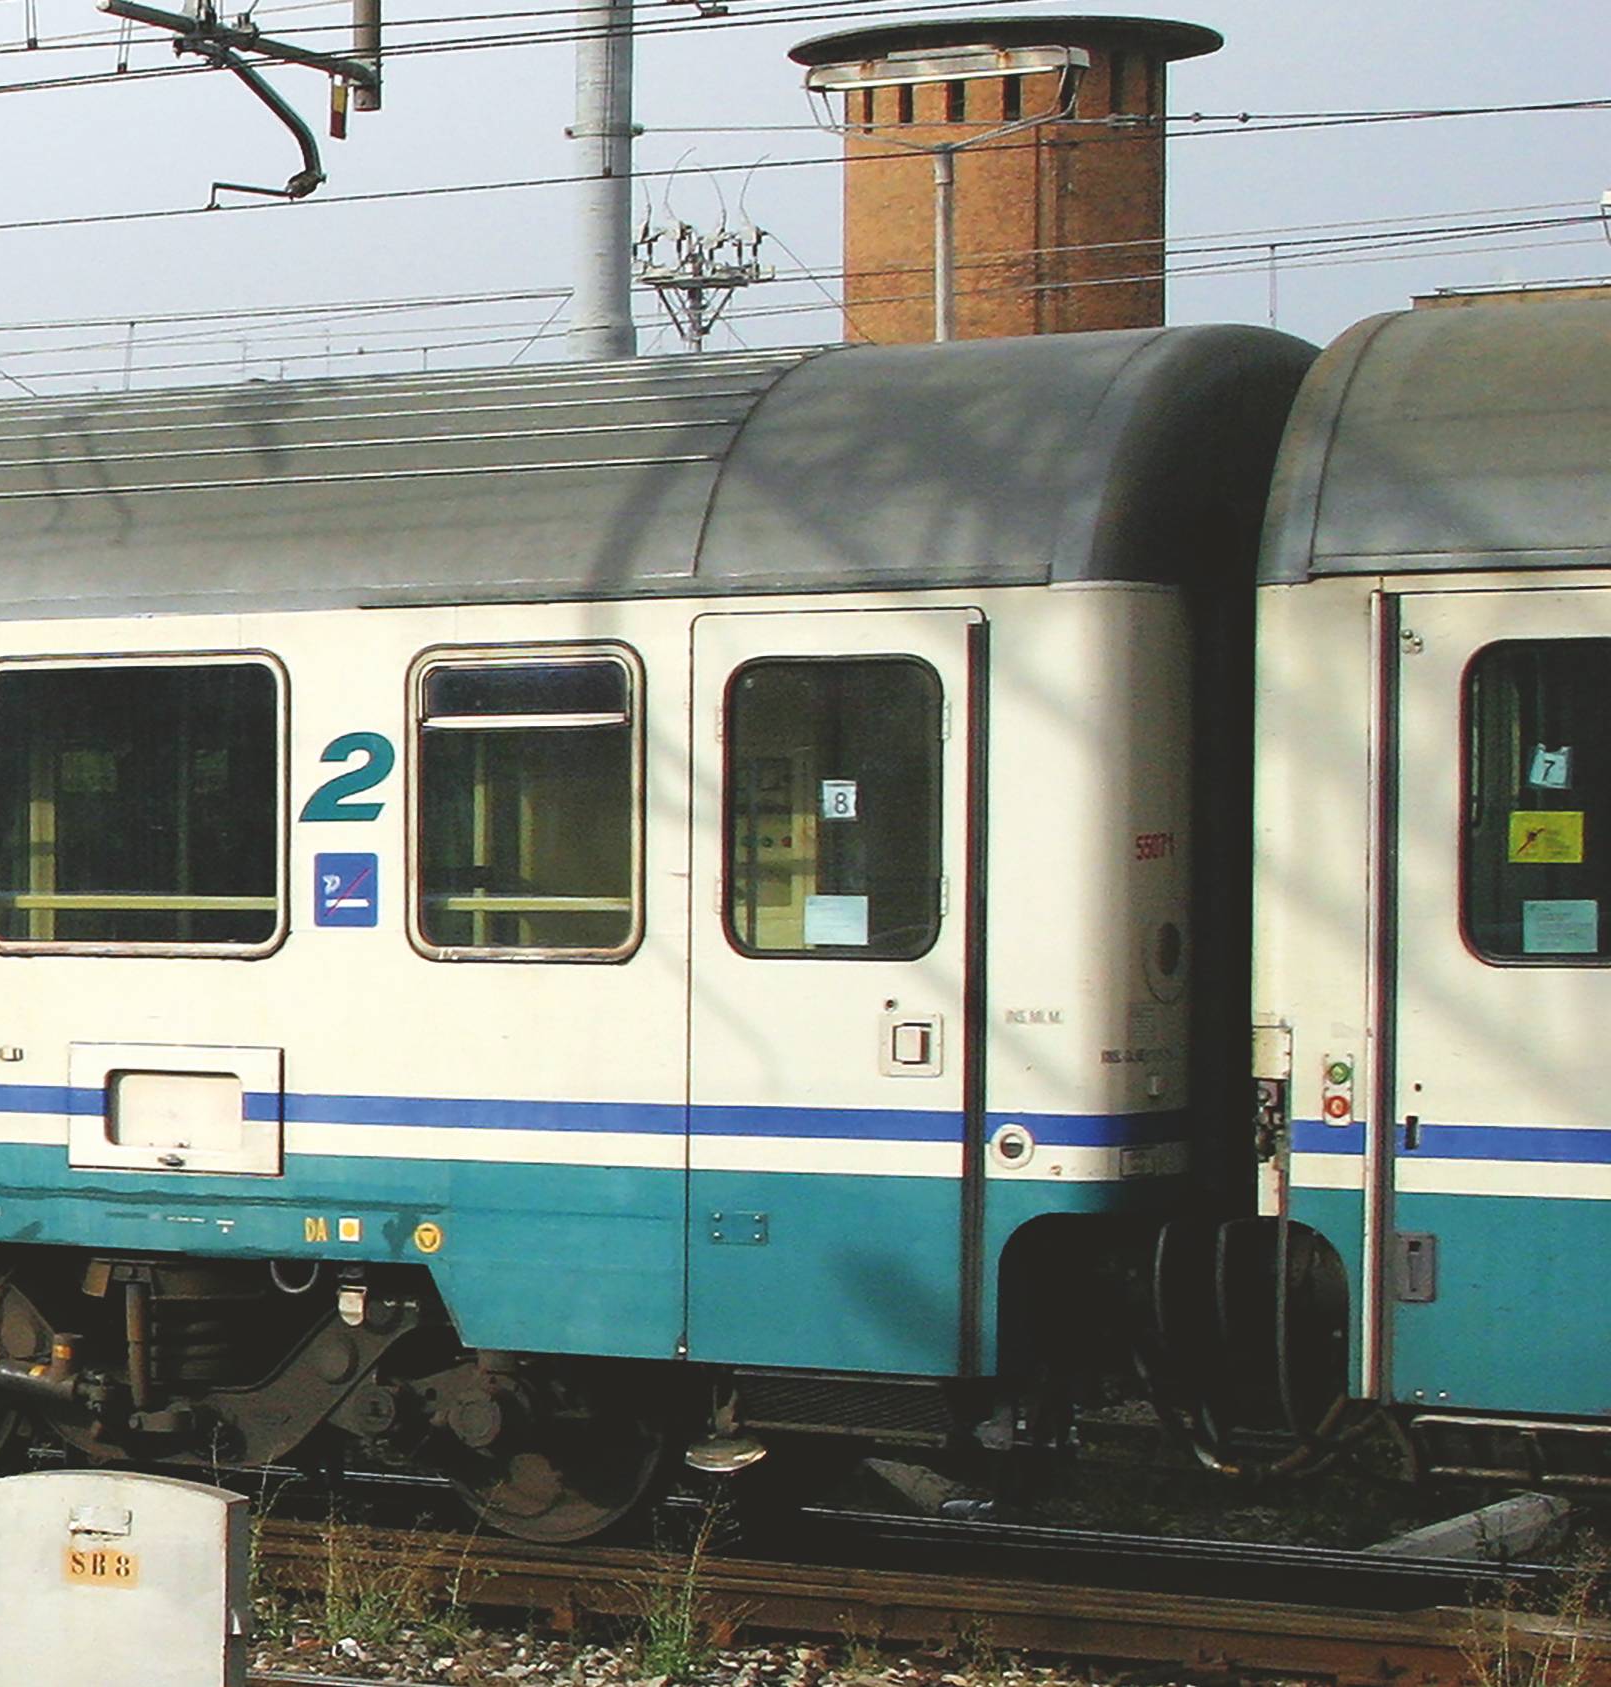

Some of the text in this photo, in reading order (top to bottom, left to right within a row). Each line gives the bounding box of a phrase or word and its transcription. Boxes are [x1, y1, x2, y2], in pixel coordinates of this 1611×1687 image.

[299, 731, 395, 822] 2
[1542, 760, 1556, 781] 7
[835, 792, 849, 814] 8
[115, 1555, 130, 1577] 8
